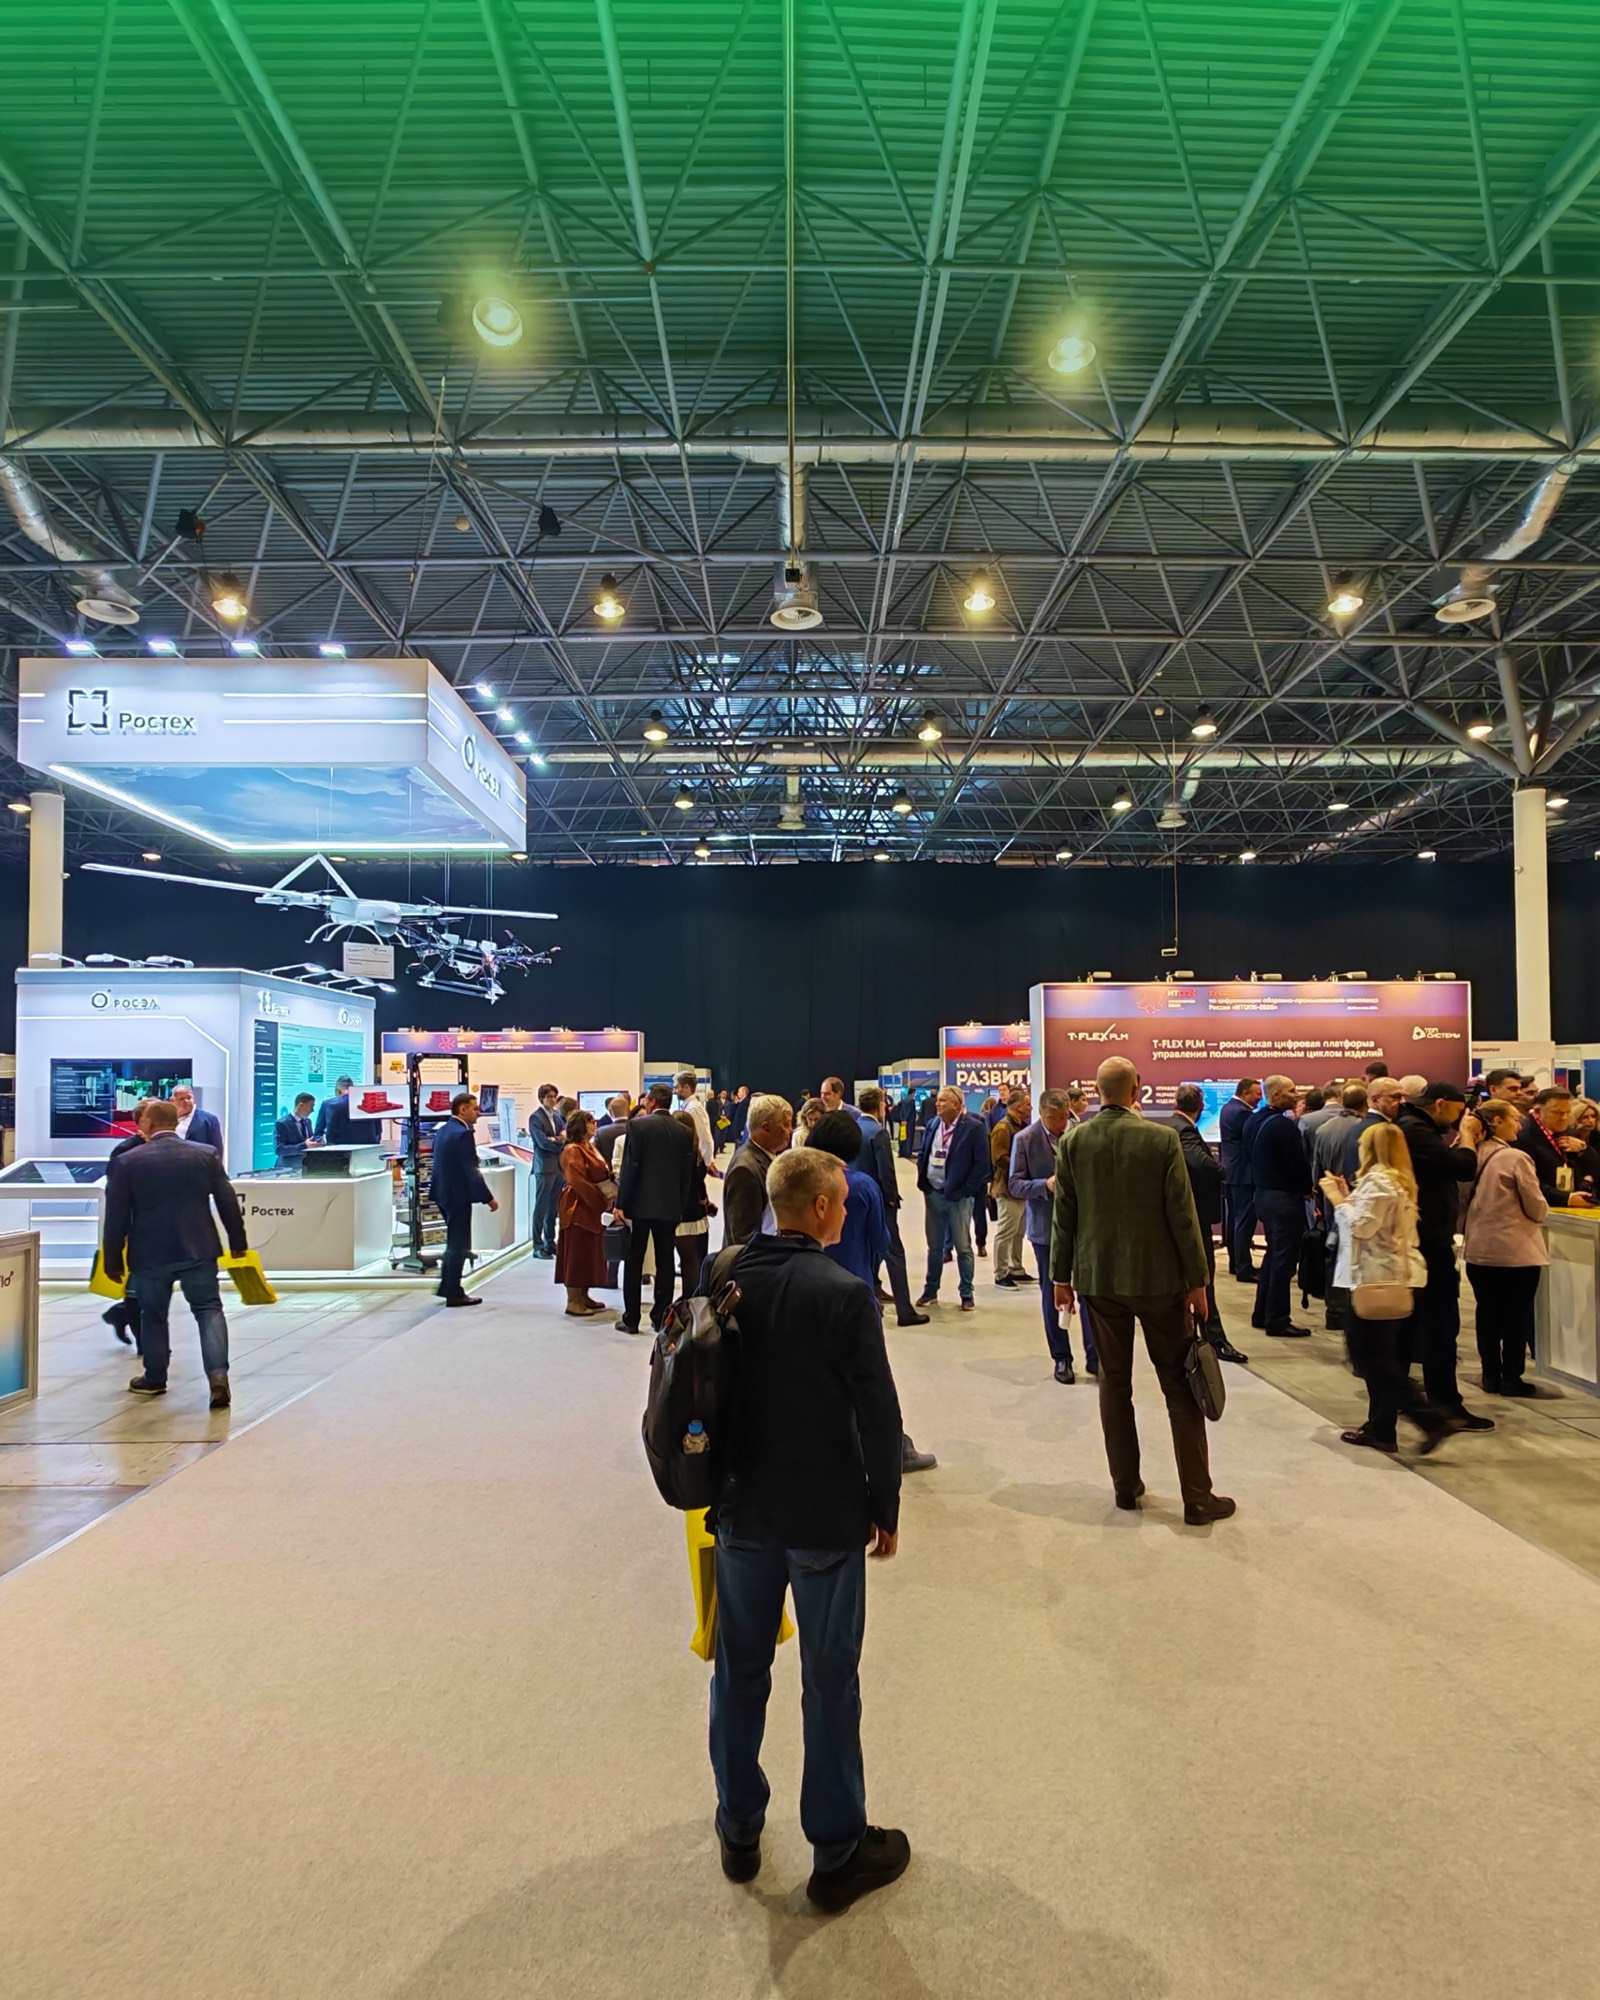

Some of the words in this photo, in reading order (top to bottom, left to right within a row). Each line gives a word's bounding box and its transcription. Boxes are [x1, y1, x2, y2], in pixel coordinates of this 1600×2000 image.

[119, 712, 195, 730] Ростех
[1109, 1033, 1129, 1041] PLM
[1152, 1039, 1183, 1049] T-FLEX
[1185, 1039, 1205, 1049] PLM
[1219, 1038, 1272, 1050] российская
[1274, 1039, 1321, 1050] цифровая
[1323, 1038, 1375, 1050] платформа
[1152, 1050, 1208, 1060] управления
[1209, 1050, 1247, 1058] полным
[1249, 1050, 1304, 1058] жизненным
[1306, 1050, 1343, 1059] циклом
[1344, 1048, 1384, 1059] изделий
[1141, 1085, 1153, 1104] 2
[251, 1206, 294, 1216] Ростех
